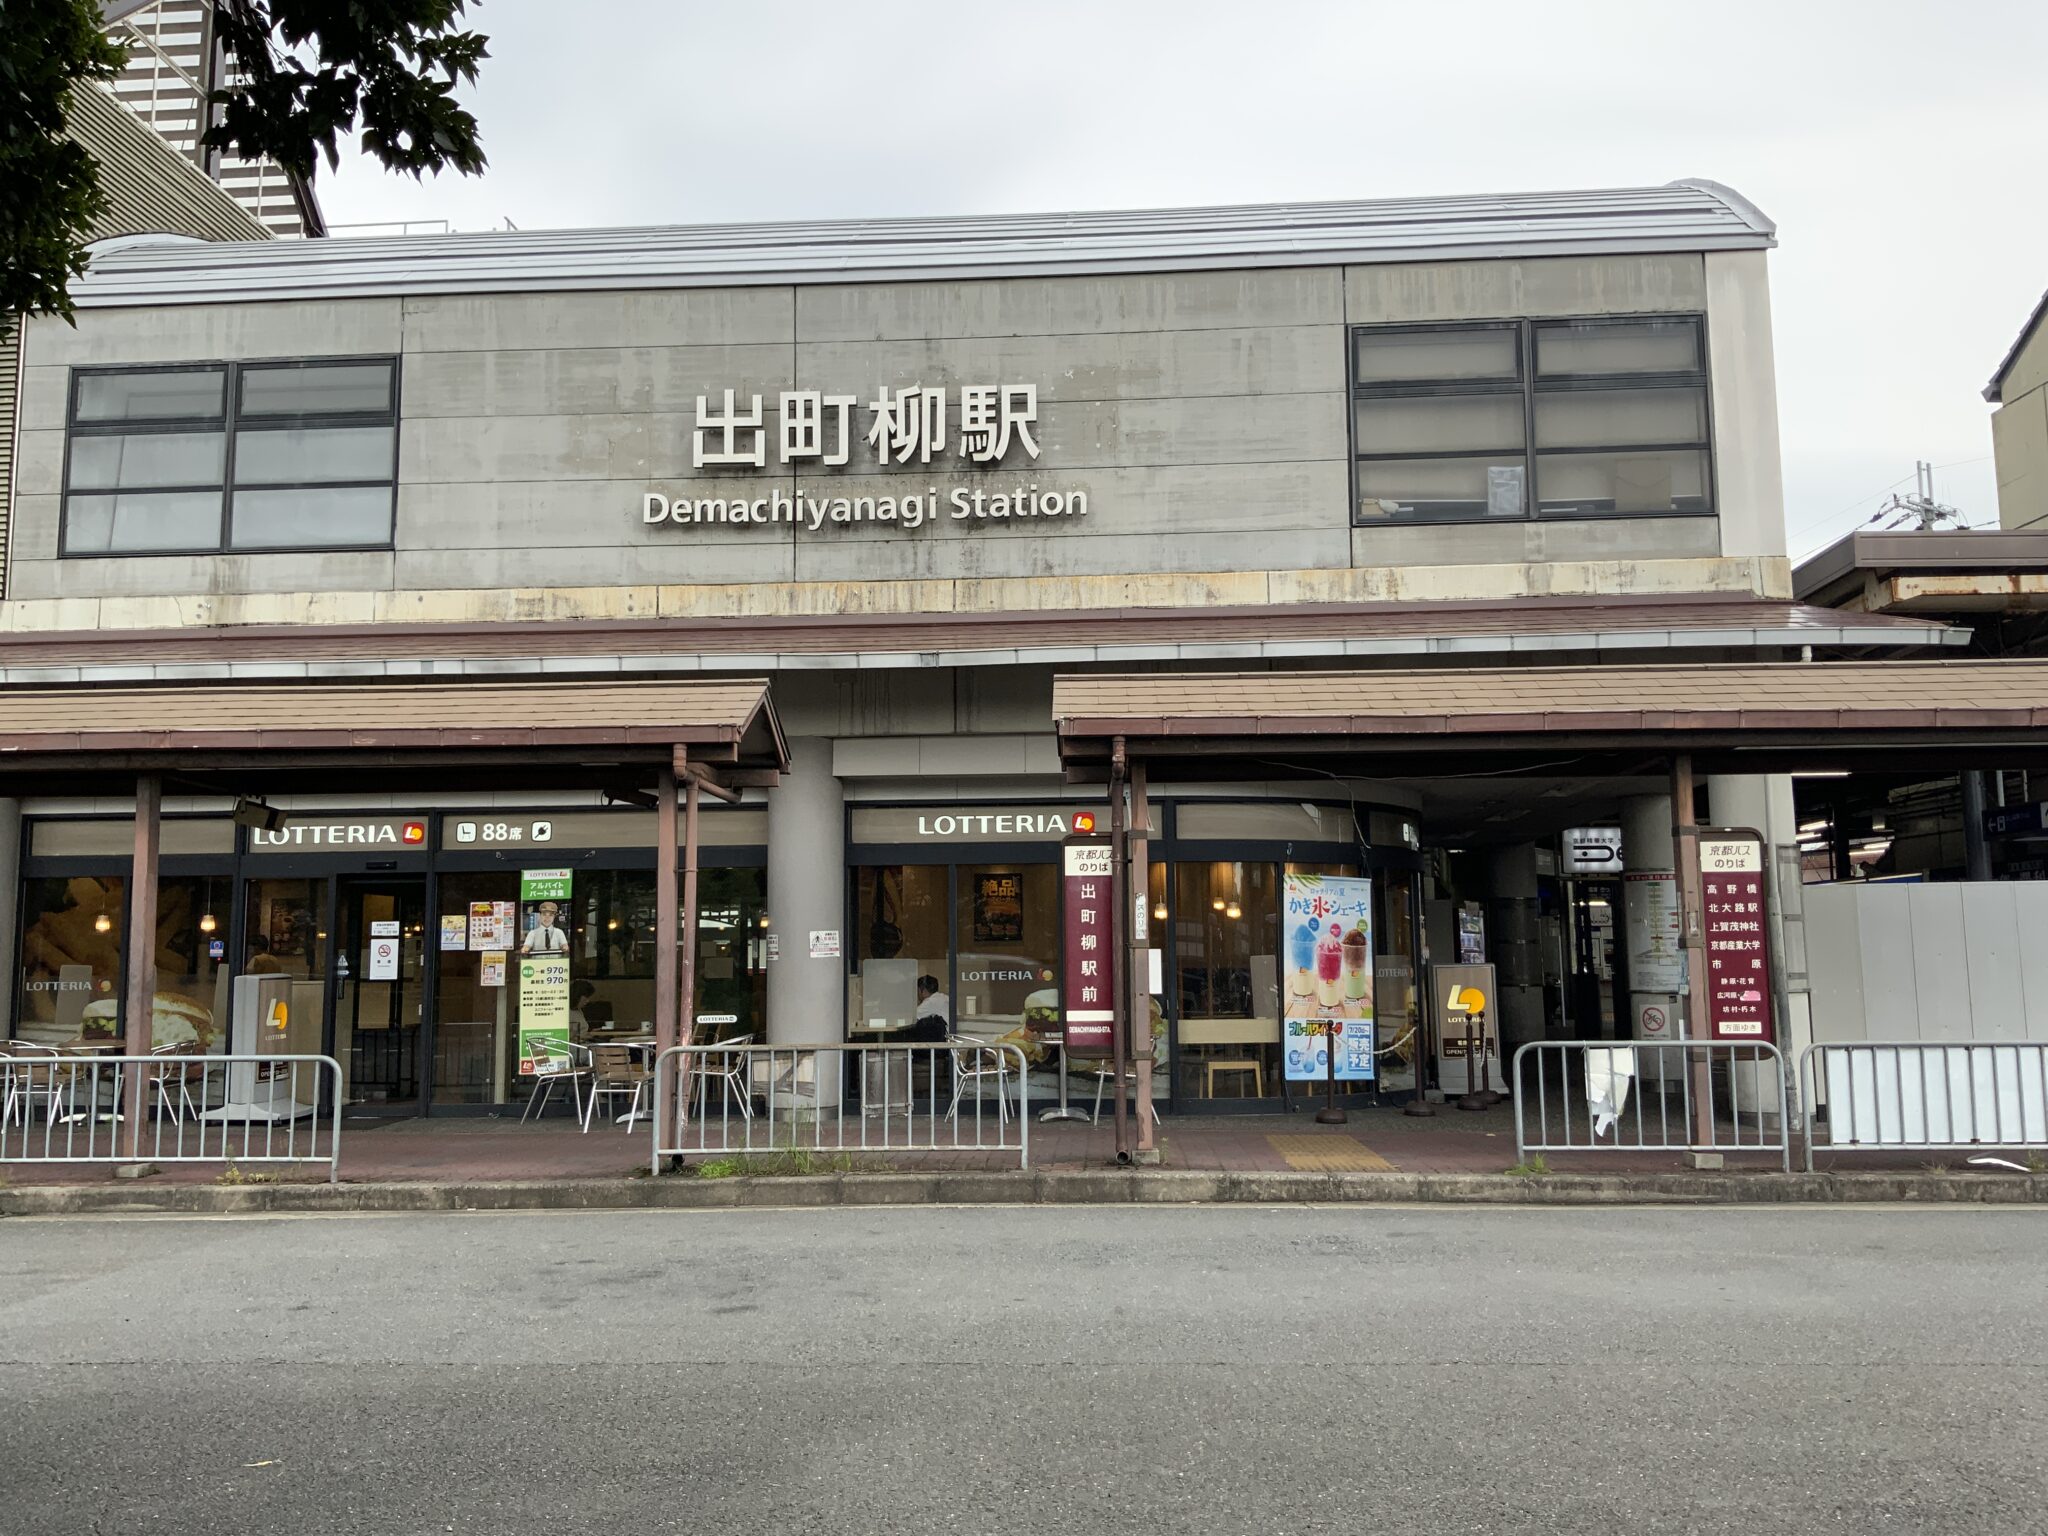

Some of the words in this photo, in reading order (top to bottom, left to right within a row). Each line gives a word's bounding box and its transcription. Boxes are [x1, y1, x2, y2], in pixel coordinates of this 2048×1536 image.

[693, 384, 1040, 468] 出町柳駅
[643, 487, 937, 530] Demachiyanagi
[951, 484, 1087, 519] Station
[919, 814, 1067, 835] LOTTERIA
[253, 825, 397, 845] LOTTERIA
[482, 823, 523, 841] 88席
[1079, 862, 1109, 872] のりば
[1714, 858, 1745, 868] のりば
[529, 881, 564, 890] アルバイト
[1707, 884, 1757, 894] 高野橋
[1289, 896, 1367, 919] かき氷シェーキ
[1708, 902, 1758, 913] 北大路駅
[1709, 921, 1760, 932] 上賀茂神社
[1080, 883, 1098, 1002] 出町柳駅前
[1710, 940, 1761, 951] 京都産業大学
[961, 970, 1033, 981] LOTTERIA
[26, 981, 92, 991] LOTTERIA
[1725, 1024, 1757, 1032] 方面ゆき
